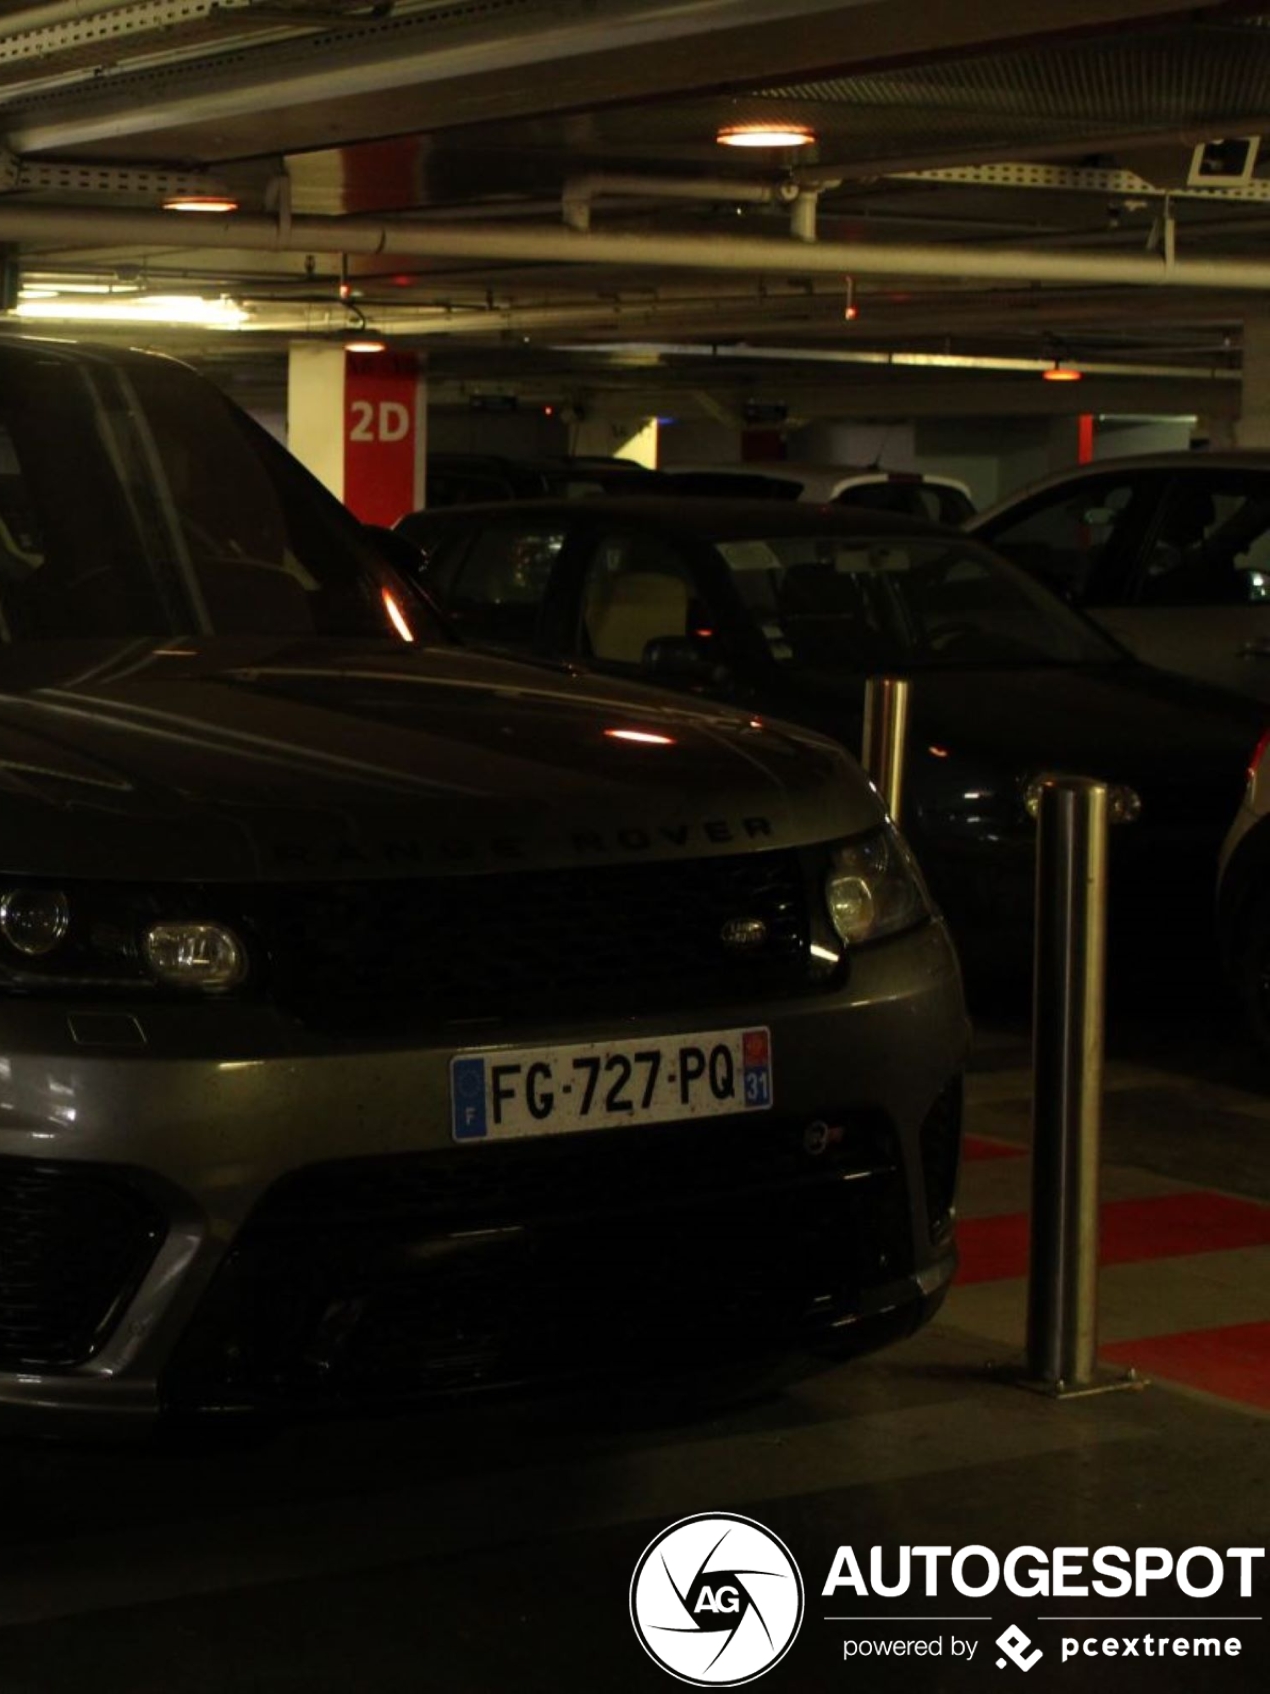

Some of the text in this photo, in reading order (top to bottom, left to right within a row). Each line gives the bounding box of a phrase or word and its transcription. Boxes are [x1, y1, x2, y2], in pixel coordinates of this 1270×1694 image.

[350, 401, 410, 441] 2D
[274, 817, 772, 865] RANGE ROVER
[747, 1071, 768, 1100] 31
[465, 1108, 476, 1126] F
